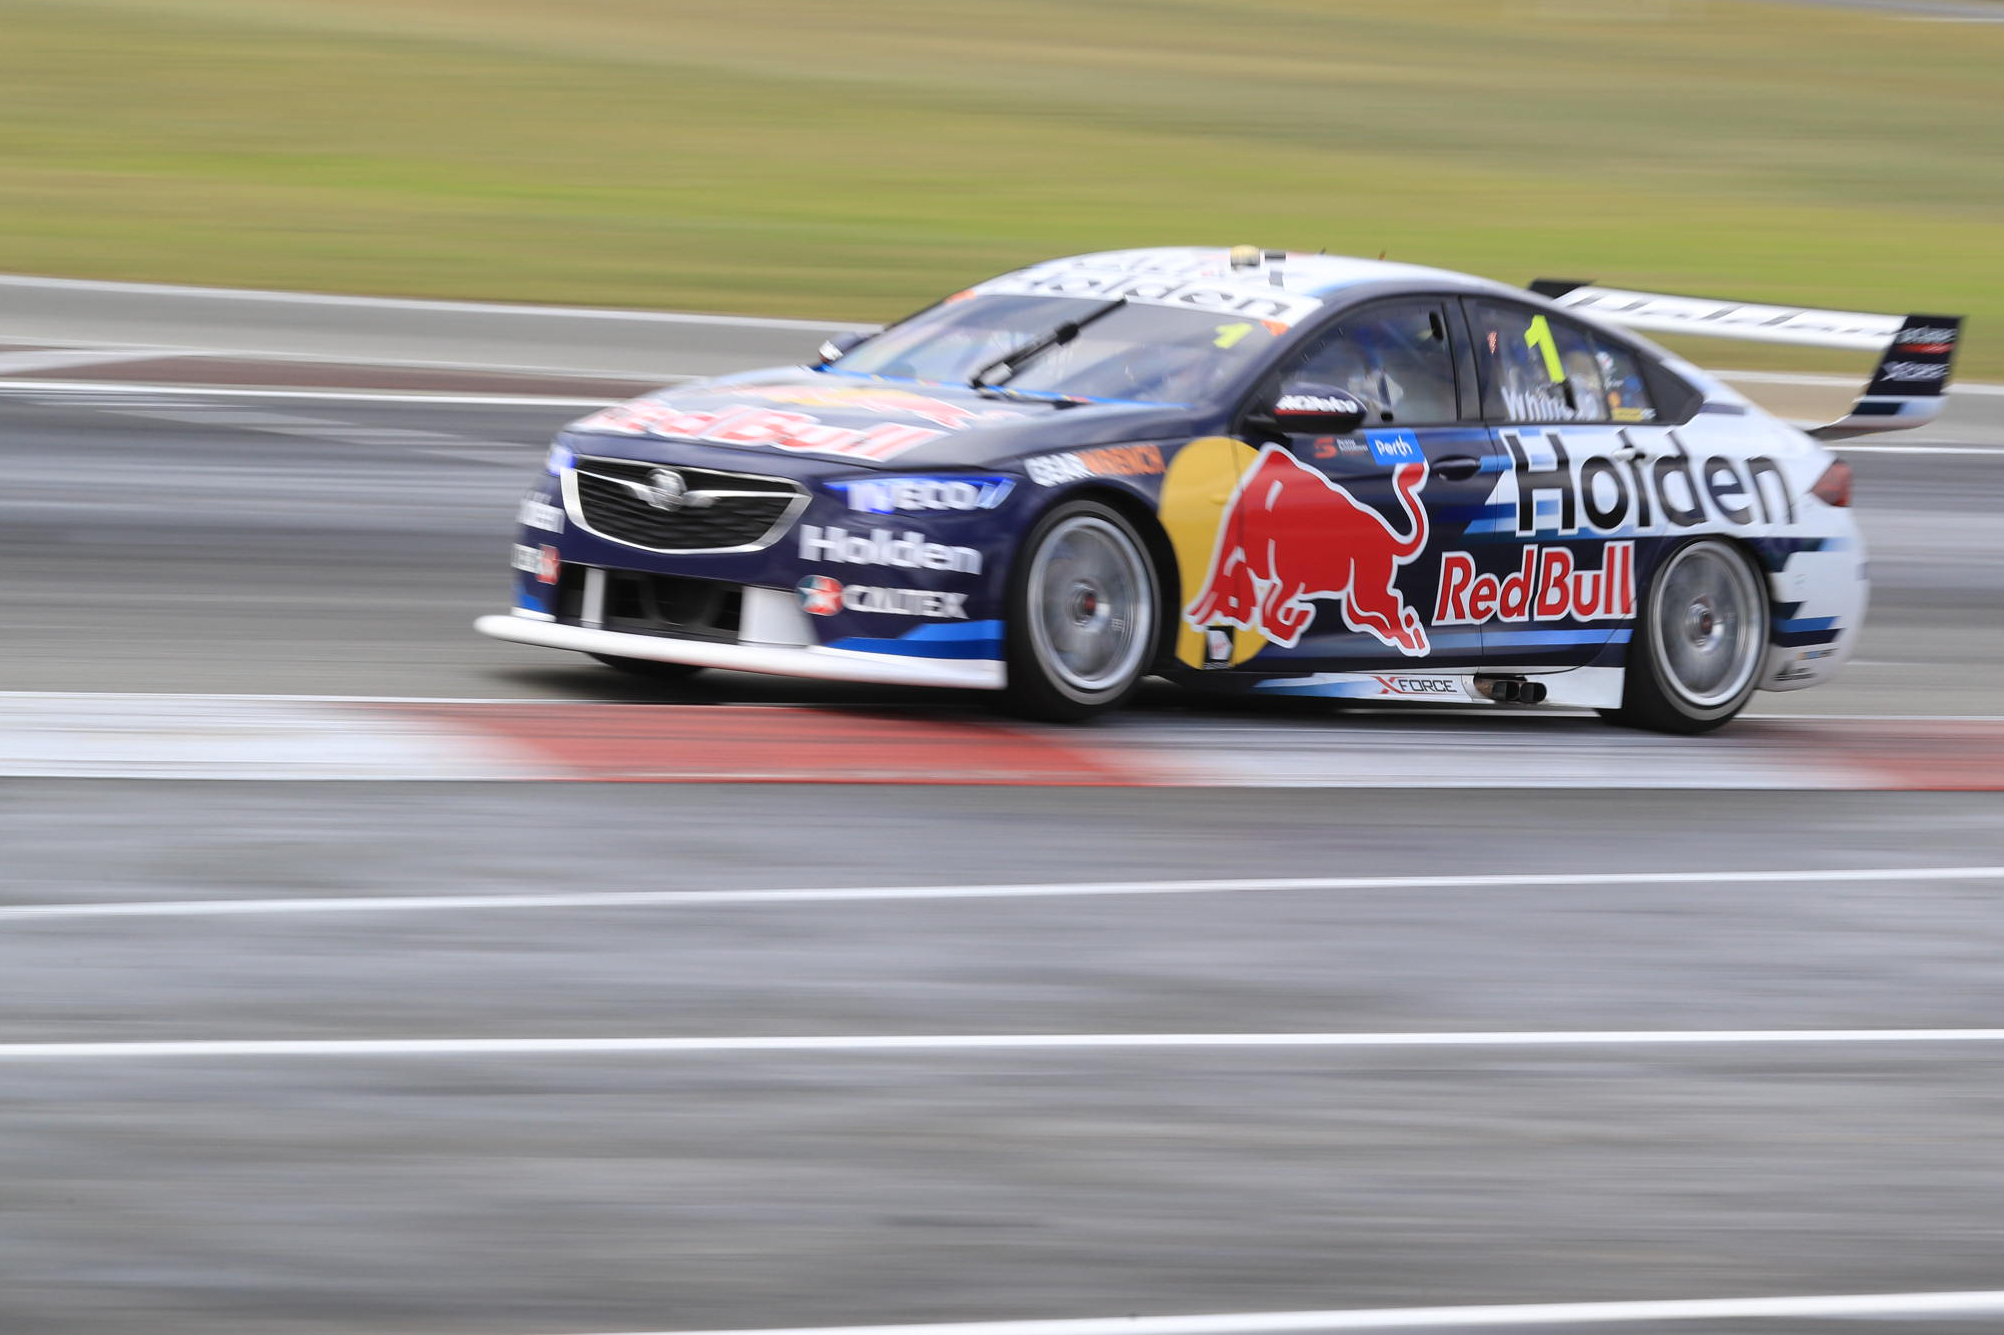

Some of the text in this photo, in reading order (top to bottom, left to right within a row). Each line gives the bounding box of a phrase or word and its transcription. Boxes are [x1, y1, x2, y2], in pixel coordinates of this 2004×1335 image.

[1524, 314, 1566, 383] 1
[1375, 435, 1413, 457] Perth
[1503, 428, 1795, 533] Holden
[799, 525, 982, 576] Holden
[843, 584, 970, 619] CALTEX
[1434, 541, 1635, 624] Red Bull
